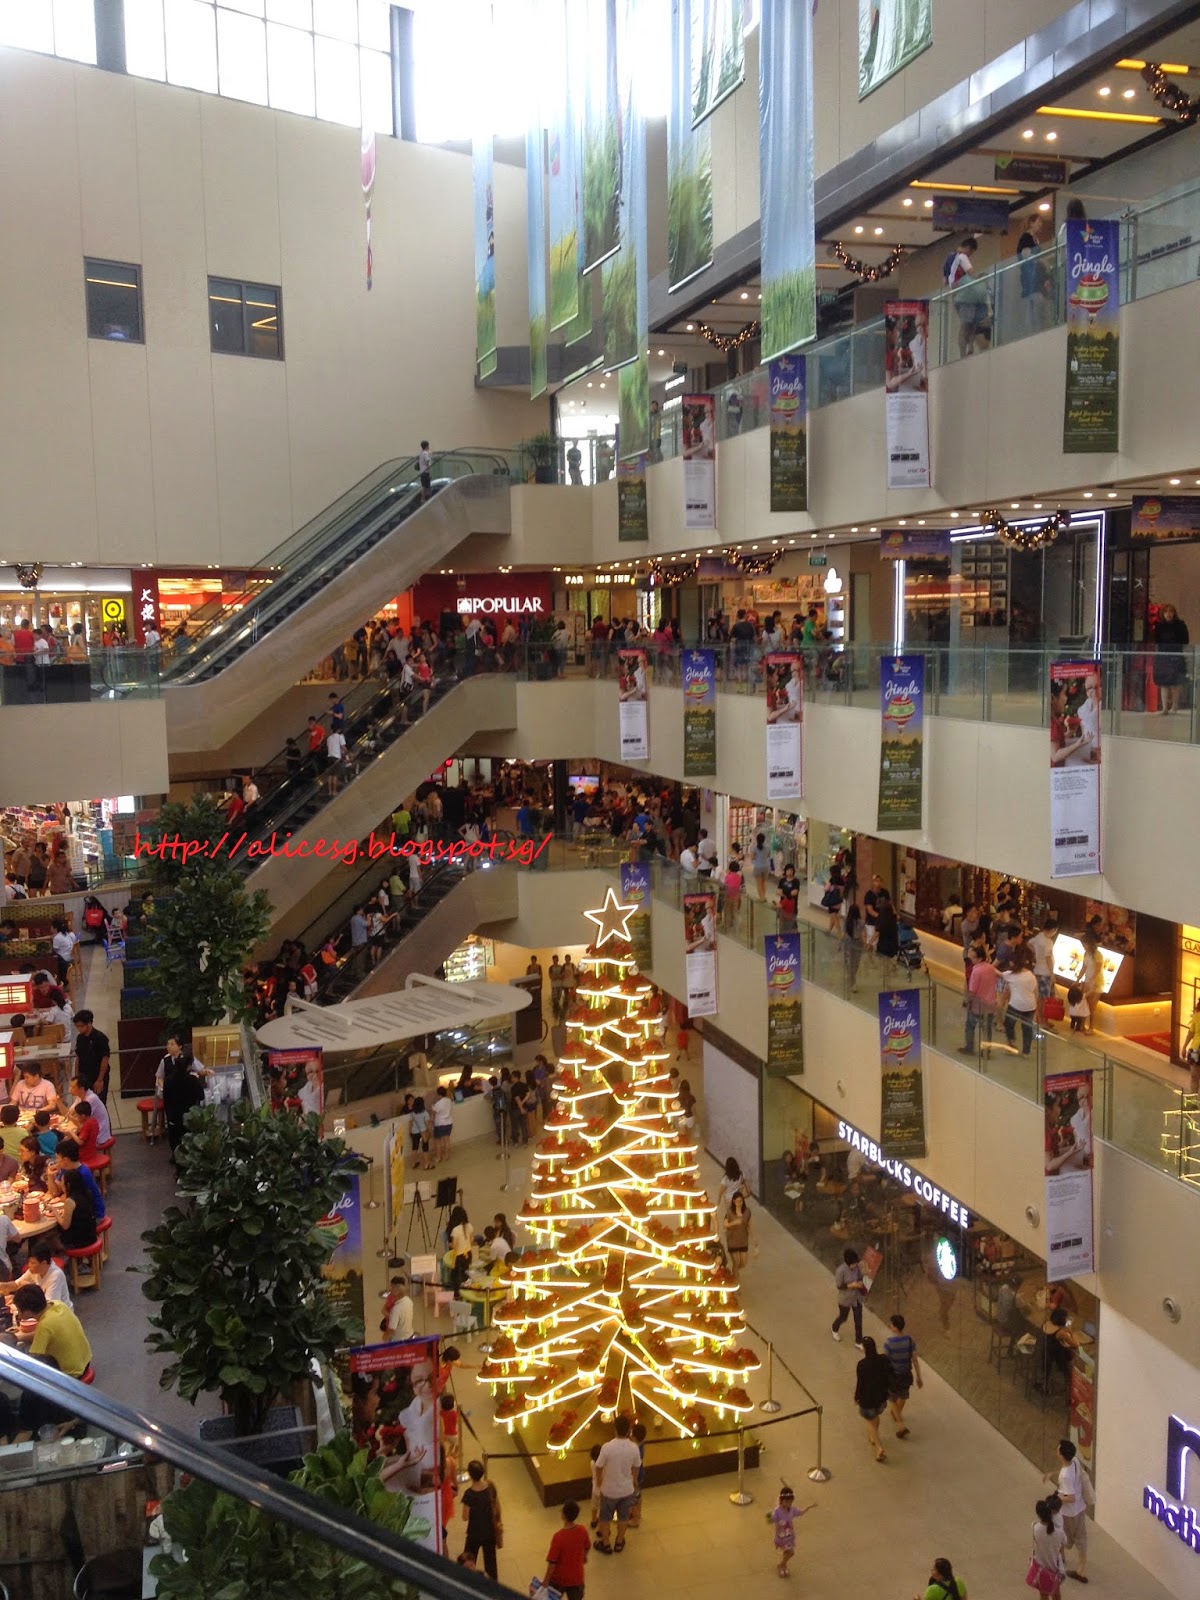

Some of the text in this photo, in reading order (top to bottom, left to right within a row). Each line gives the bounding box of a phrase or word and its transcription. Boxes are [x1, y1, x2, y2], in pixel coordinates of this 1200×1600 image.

[1071, 252, 1115, 281] Jingle
[772, 377, 803, 395] Jingle
[473, 596, 544, 614] POPULAR
[685, 665, 712, 681] Jingle
[885, 680, 920, 699] Jingle
[624, 878, 648, 890] Jingle
[769, 954, 798, 971] Jingle
[883, 1013, 917, 1035] Jingle
[838, 1120, 969, 1229] STARBUCKS COFFEE
